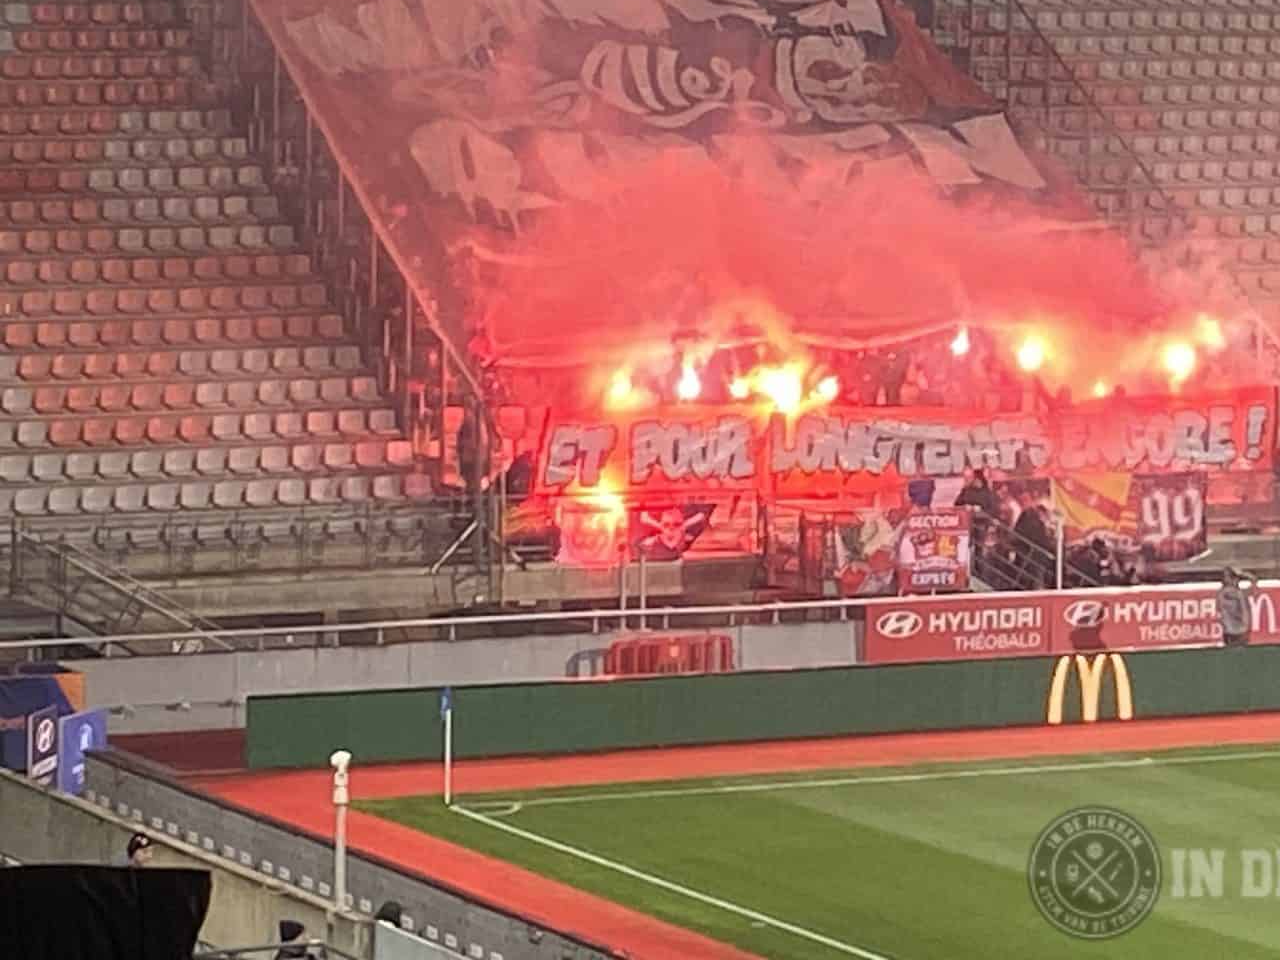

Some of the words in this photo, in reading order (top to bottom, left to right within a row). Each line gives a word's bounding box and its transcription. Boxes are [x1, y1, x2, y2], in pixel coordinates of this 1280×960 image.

[545, 423, 617, 486] ET
[629, 413, 756, 485] POUR
[1140, 486, 1203, 543] 99
[928, 606, 1042, 633] HYUNDAI
[1114, 598, 1221, 623] HYUNDA
[953, 632, 1041, 652] THÉOBALD
